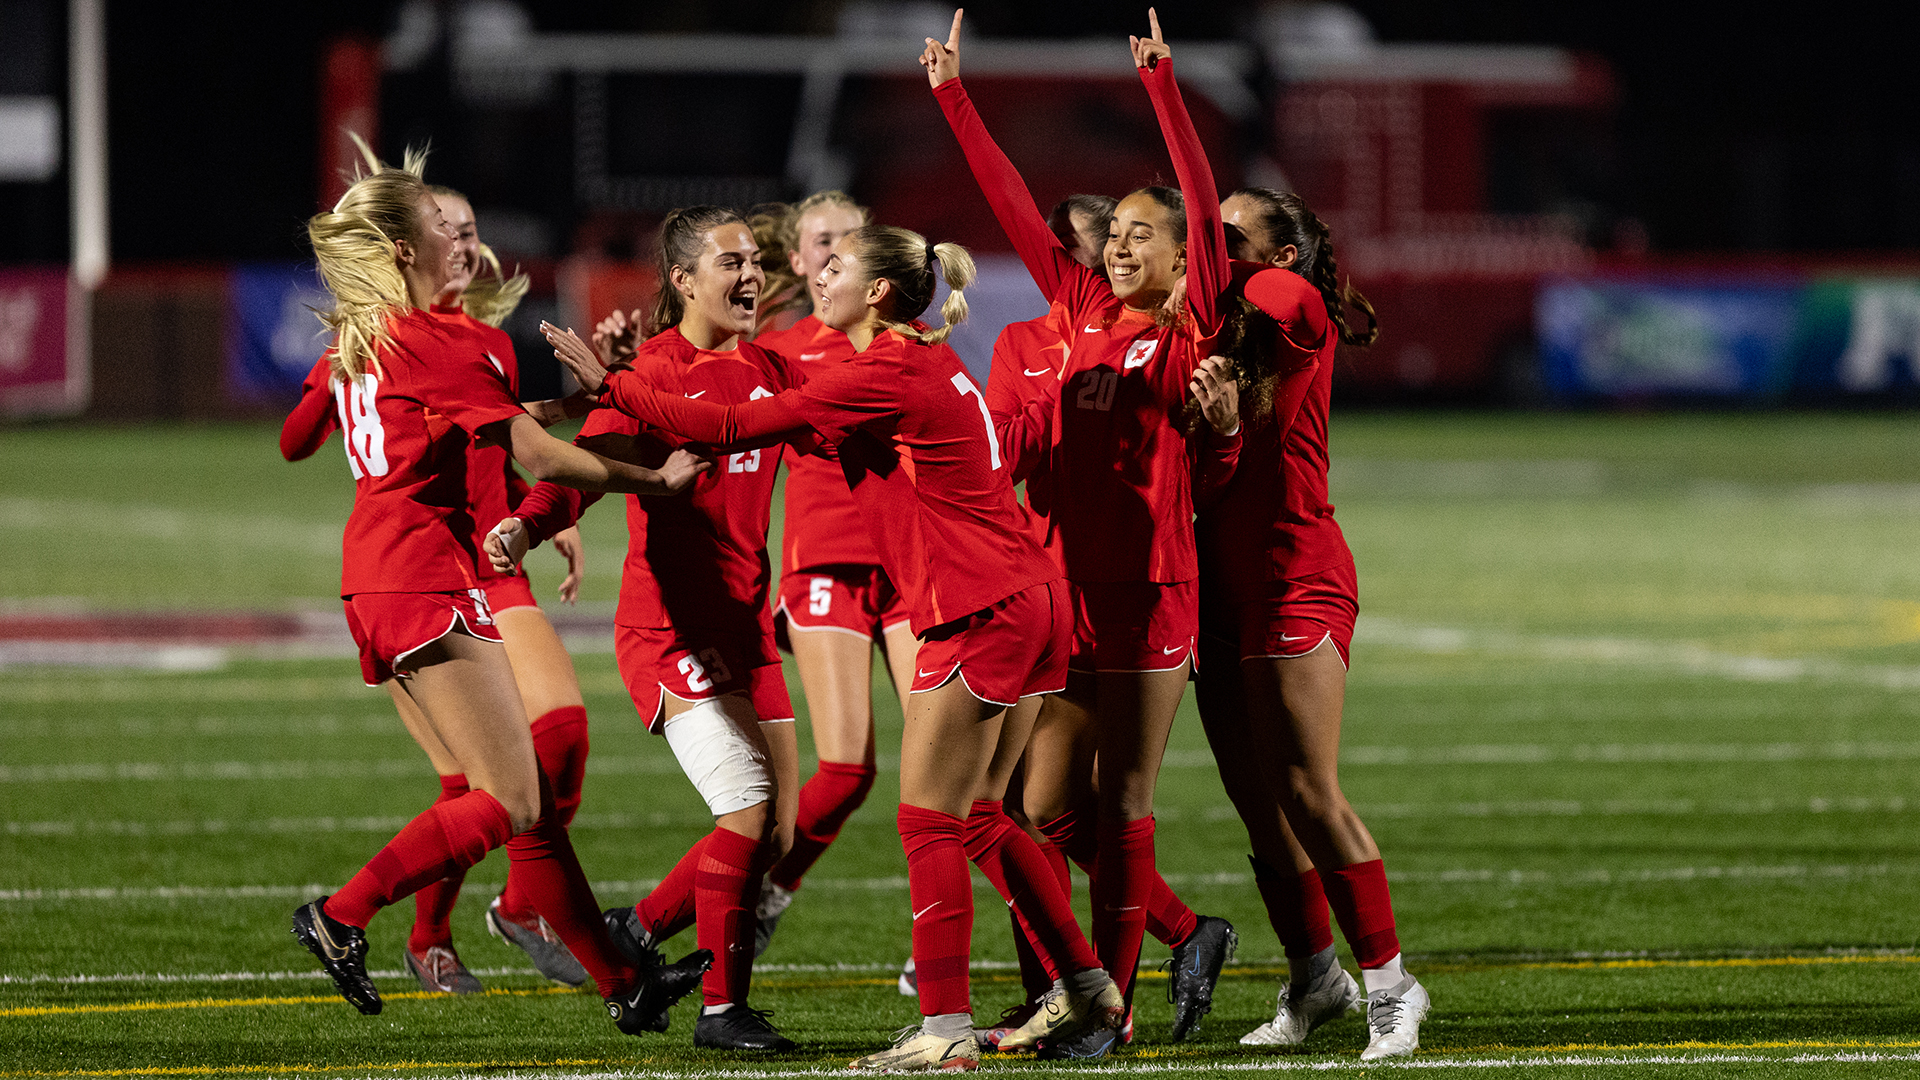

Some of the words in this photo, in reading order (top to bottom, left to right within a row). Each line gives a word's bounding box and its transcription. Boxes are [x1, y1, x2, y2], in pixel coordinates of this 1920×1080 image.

[1077, 370, 1118, 411] 20
[334, 373, 389, 480] 18
[809, 577, 834, 617] 5
[677, 647, 732, 693] 23
